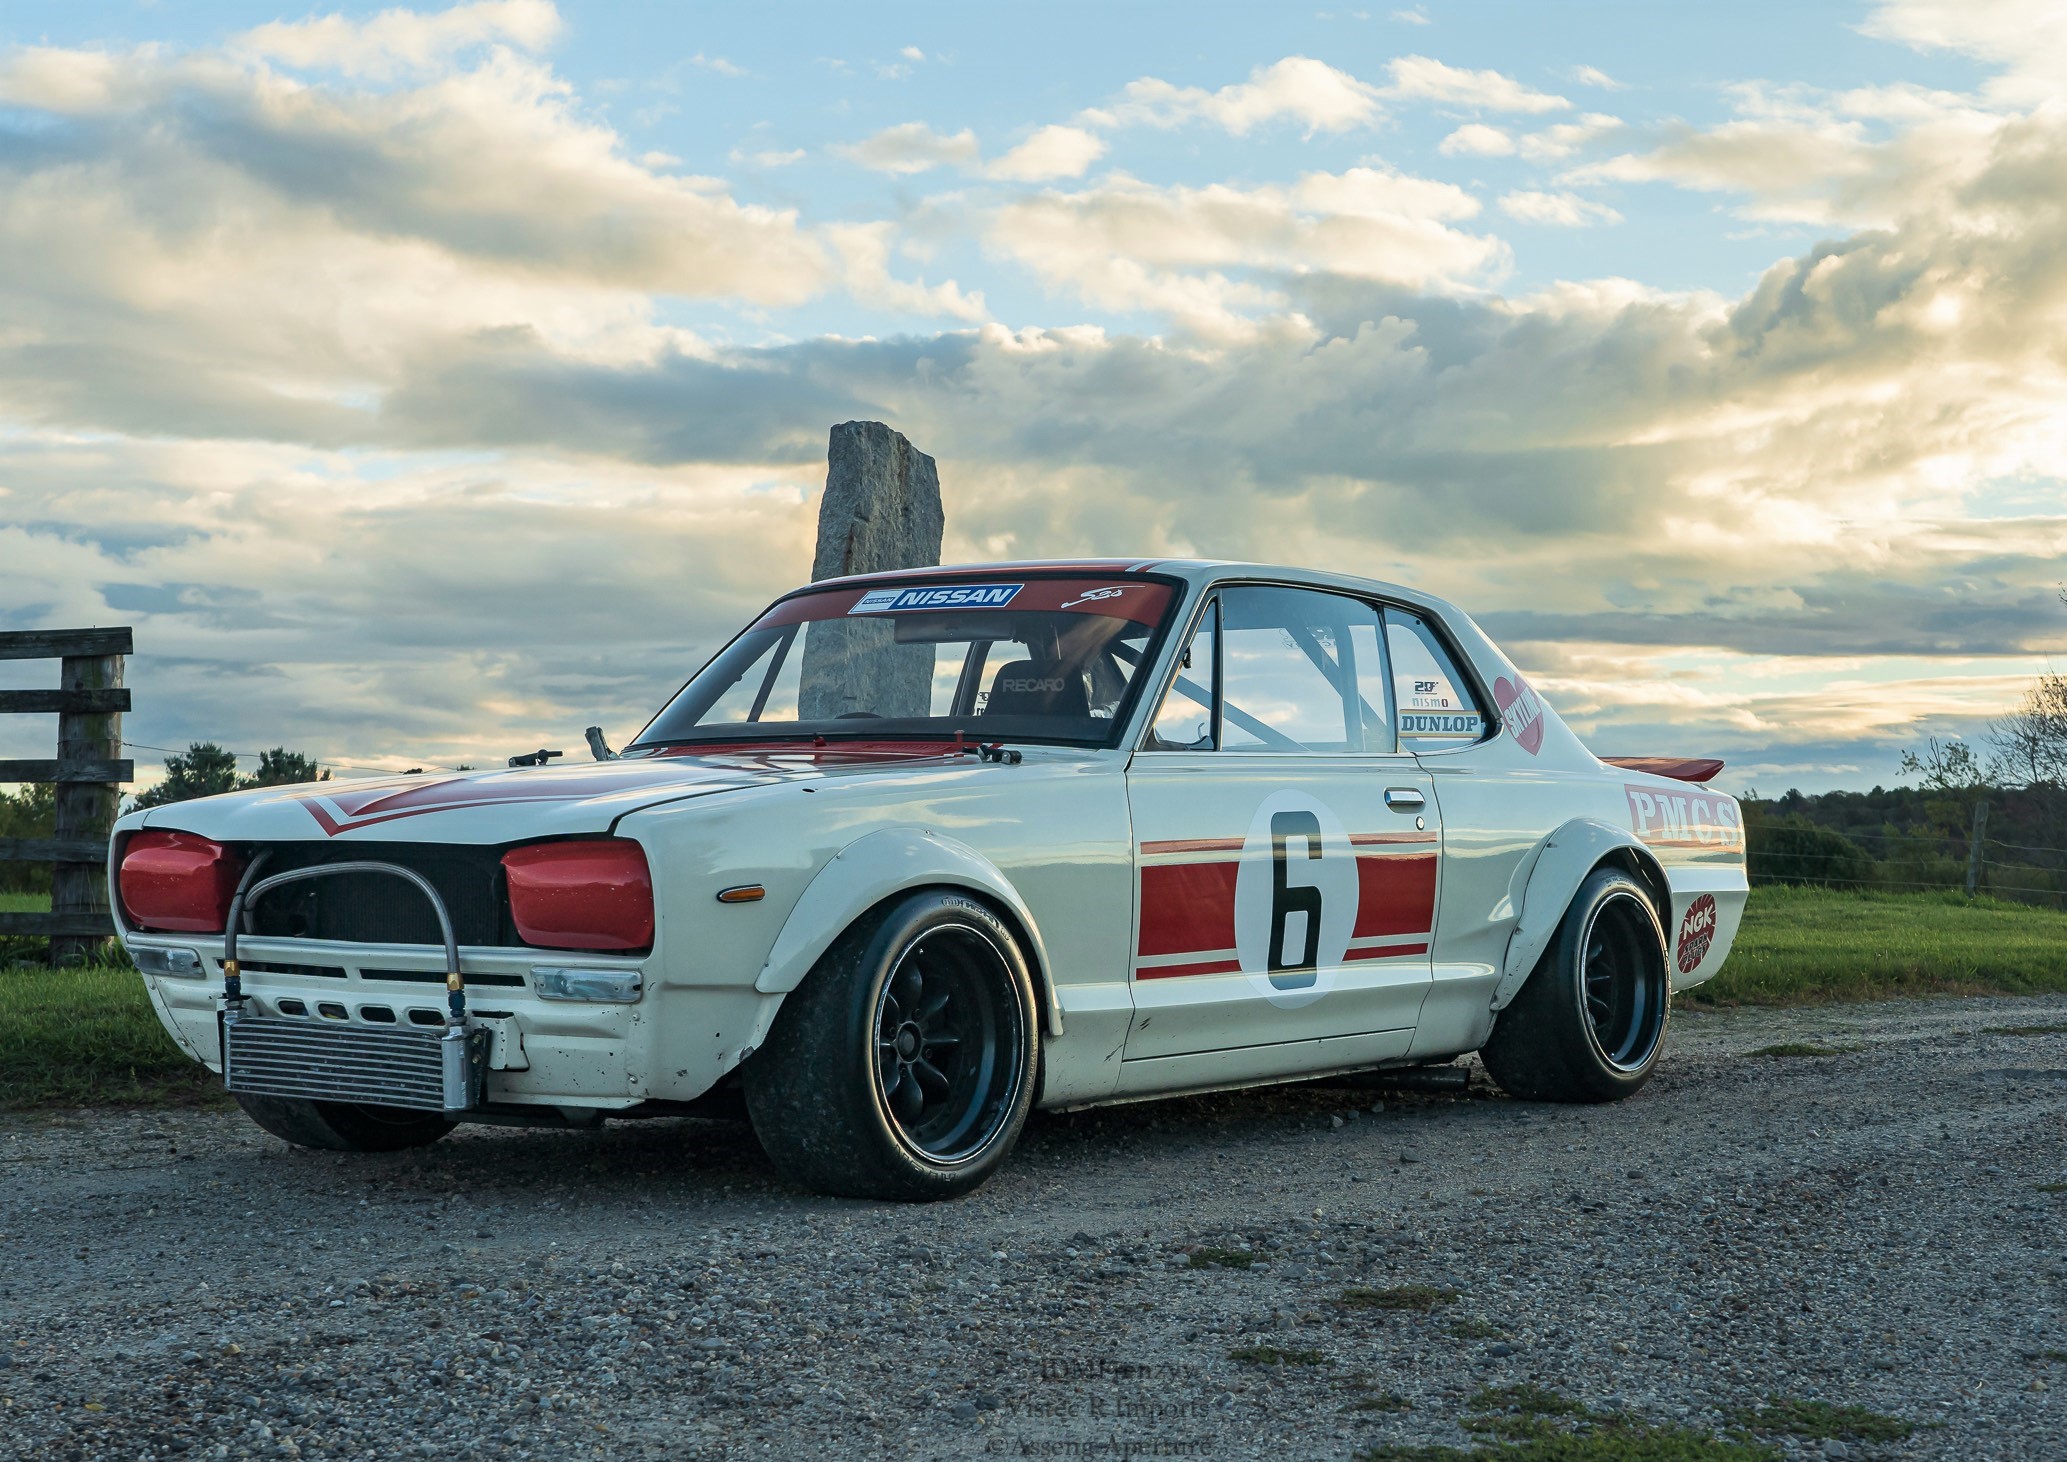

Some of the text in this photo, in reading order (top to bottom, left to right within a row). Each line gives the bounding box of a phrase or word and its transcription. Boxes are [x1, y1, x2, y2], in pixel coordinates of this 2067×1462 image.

[897, 588, 1013, 606] NISSAN
[1002, 678, 1065, 692] RECARO
[1401, 715, 1478, 732] DUNLOP
[1267, 810, 1323, 990] 6
[1683, 904, 1714, 941] NGK
